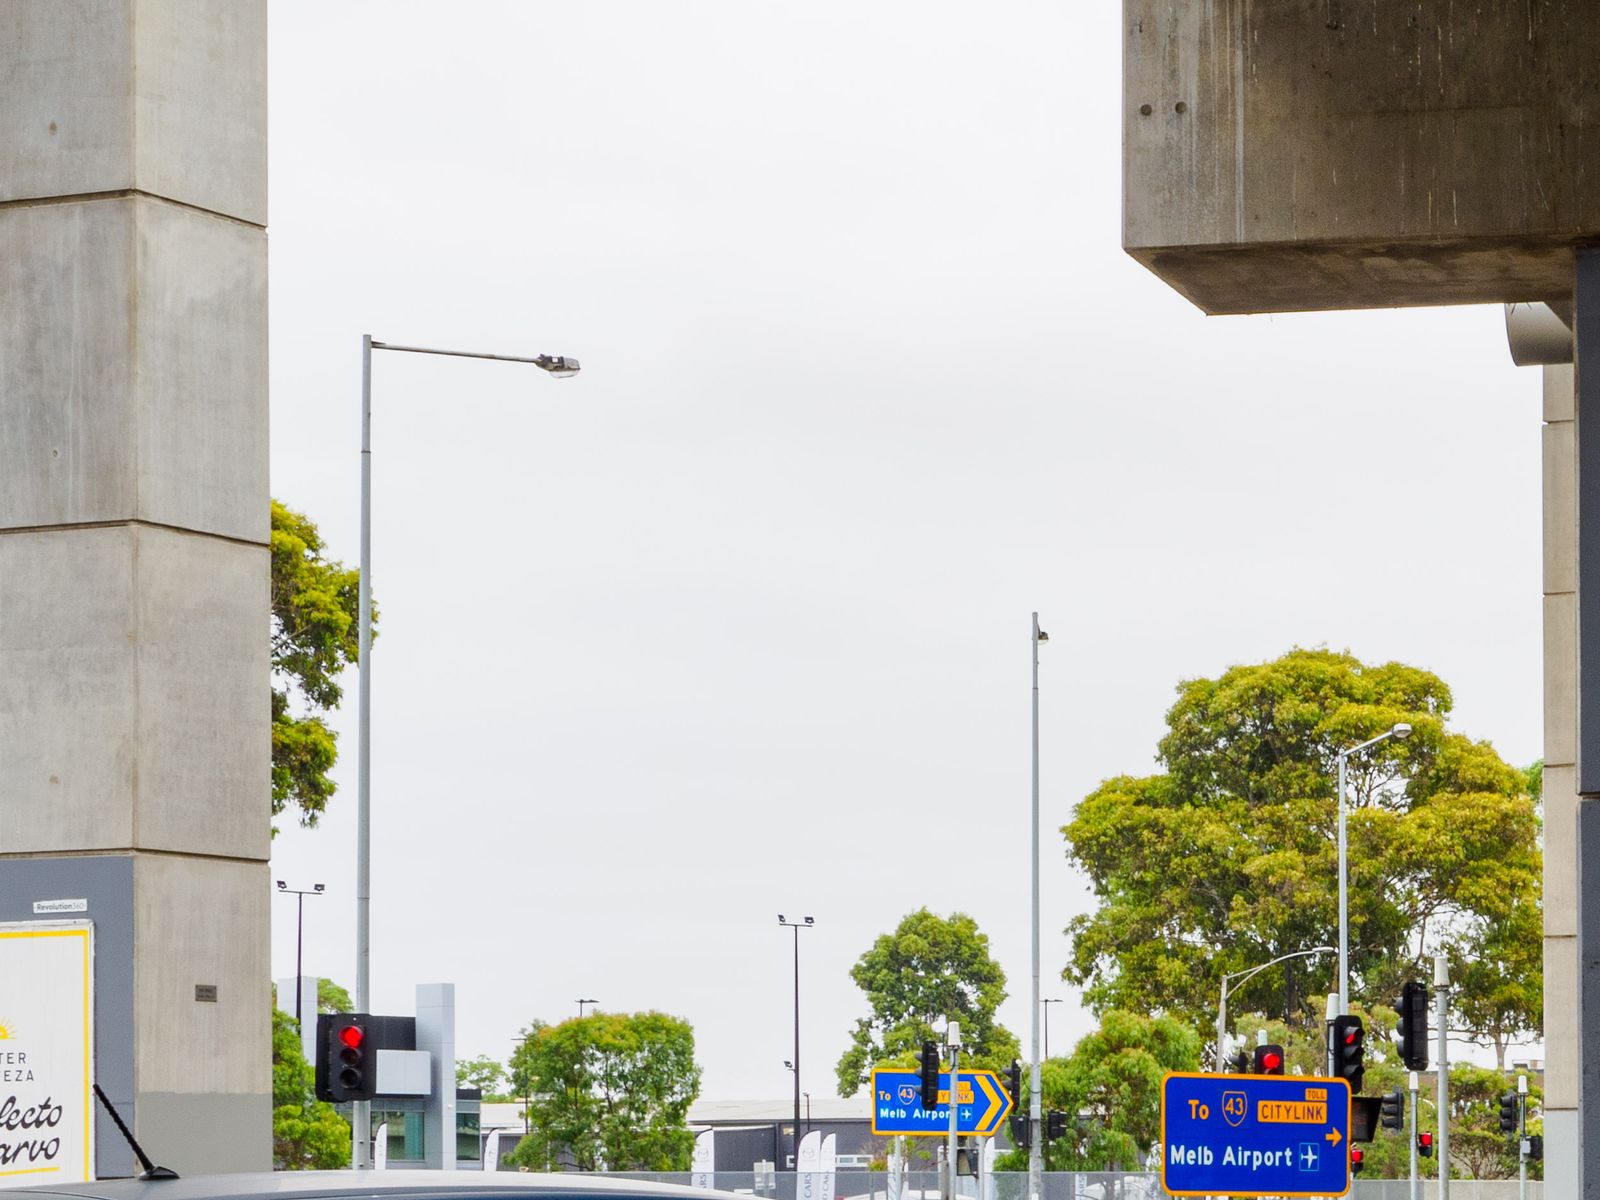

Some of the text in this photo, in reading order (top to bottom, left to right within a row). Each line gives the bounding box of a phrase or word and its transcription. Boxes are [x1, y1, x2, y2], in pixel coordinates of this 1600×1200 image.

[0, 1069, 35, 1082] EZA
[878, 1088, 913, 1101] To 43
[1307, 1089, 1325, 1099] TOLL
[880, 1108, 950, 1121] Melb Airpor
[1188, 1097, 1323, 1121] To 43 CITYLINK
[1170, 1144, 1293, 1171] Melb Airport
